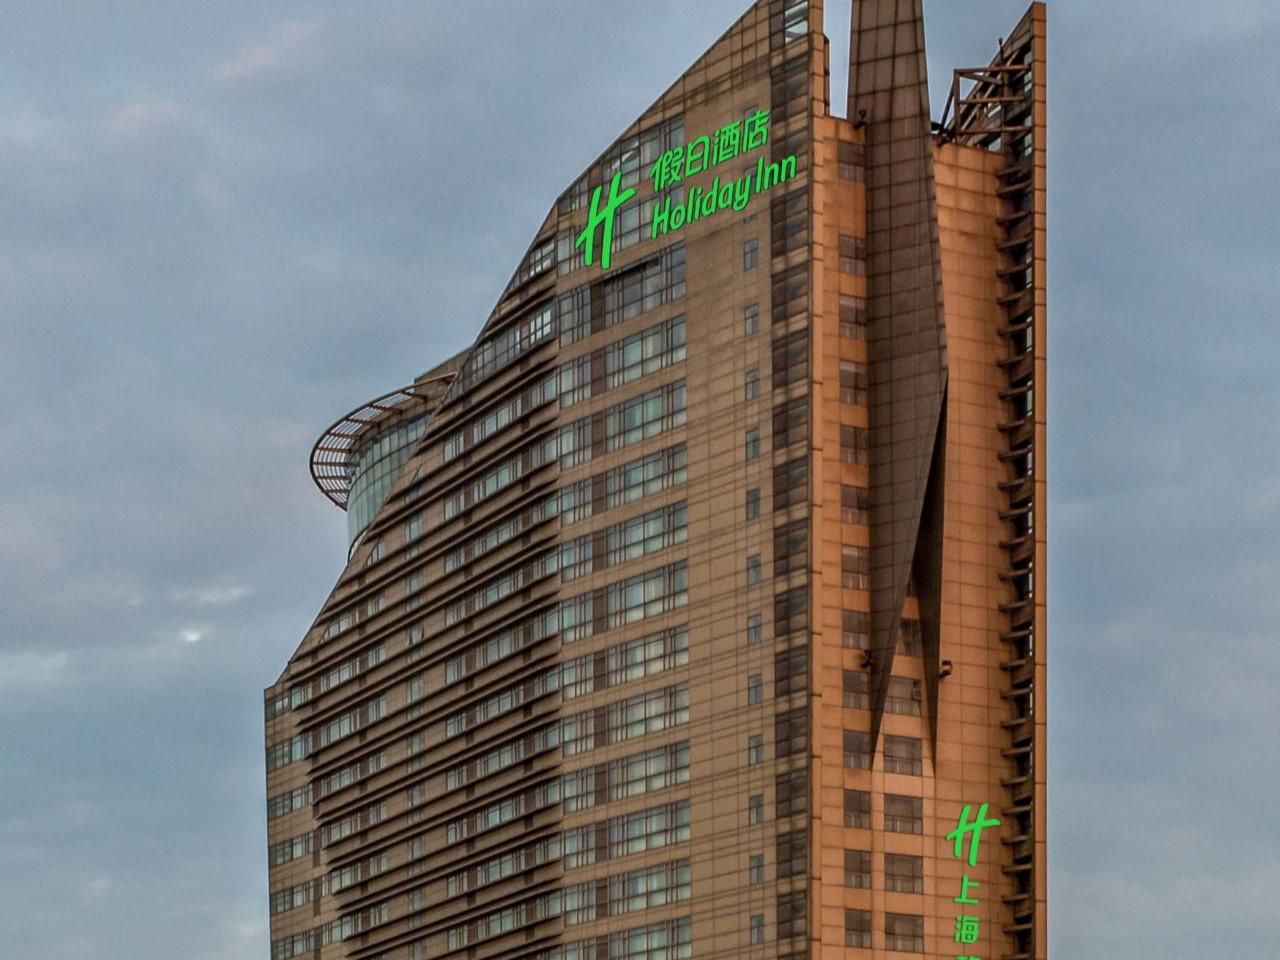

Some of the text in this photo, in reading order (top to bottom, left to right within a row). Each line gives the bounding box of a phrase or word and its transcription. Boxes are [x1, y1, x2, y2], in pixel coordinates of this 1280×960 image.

[649, 108, 773, 193] 假日酒店
[651, 153, 798, 240] Holiday Inn
